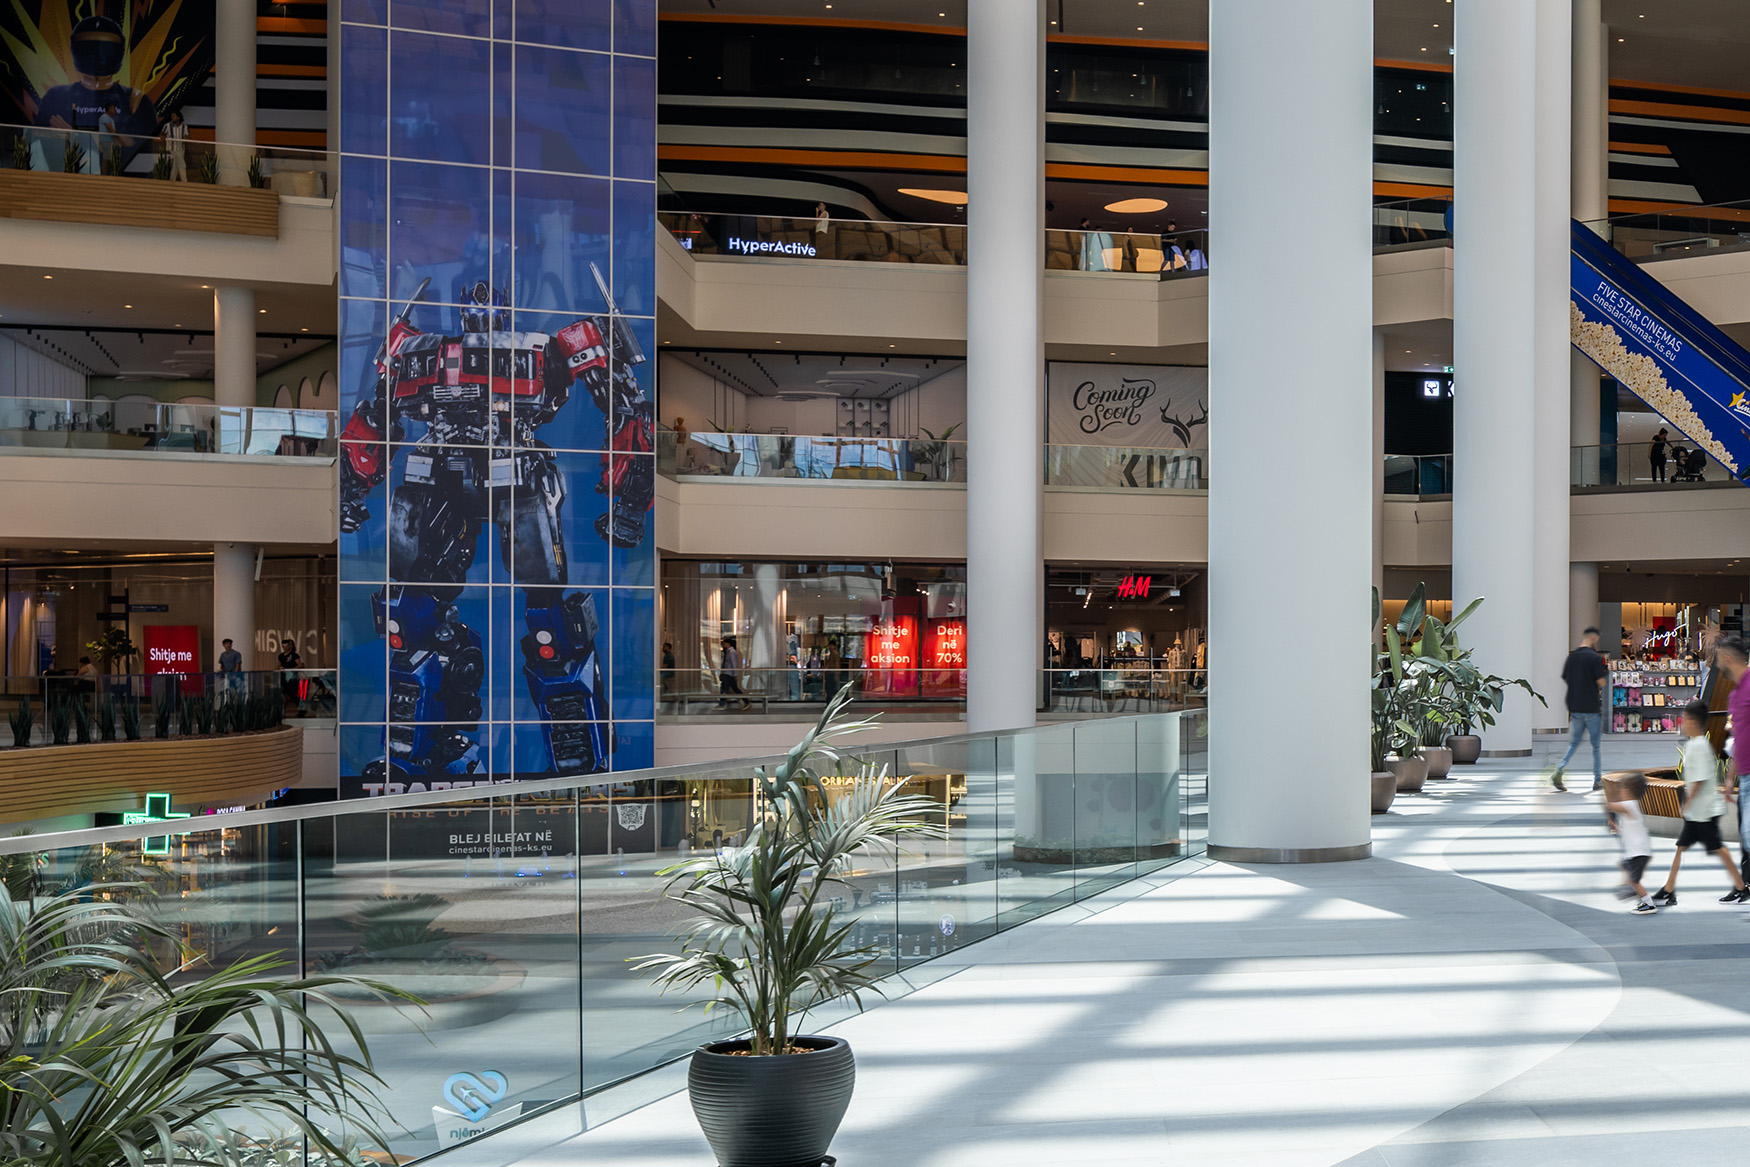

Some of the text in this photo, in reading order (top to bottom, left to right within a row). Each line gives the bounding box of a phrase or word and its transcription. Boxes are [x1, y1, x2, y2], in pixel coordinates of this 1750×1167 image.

[729, 237, 817, 257] HyperActive
[1597, 281, 1683, 352] FIVE STAR CINEMAS
[1592, 293, 1677, 362] cinestarcinemas-ks.eu
[1073, 377, 1157, 411] Coming
[1079, 403, 1142, 434] Soon
[1117, 575, 1152, 599] H&M
[873, 625, 909, 637] Shitje
[937, 625, 963, 637] Deri
[881, 640, 900, 651] me
[942, 638, 957, 651] në
[150, 647, 193, 664] Shitje me
[870, 652, 911, 665] aksion
[937, 652, 964, 665] 70%
[449, 834, 481, 845] BLEJ
[535, 830, 553, 842] NË
